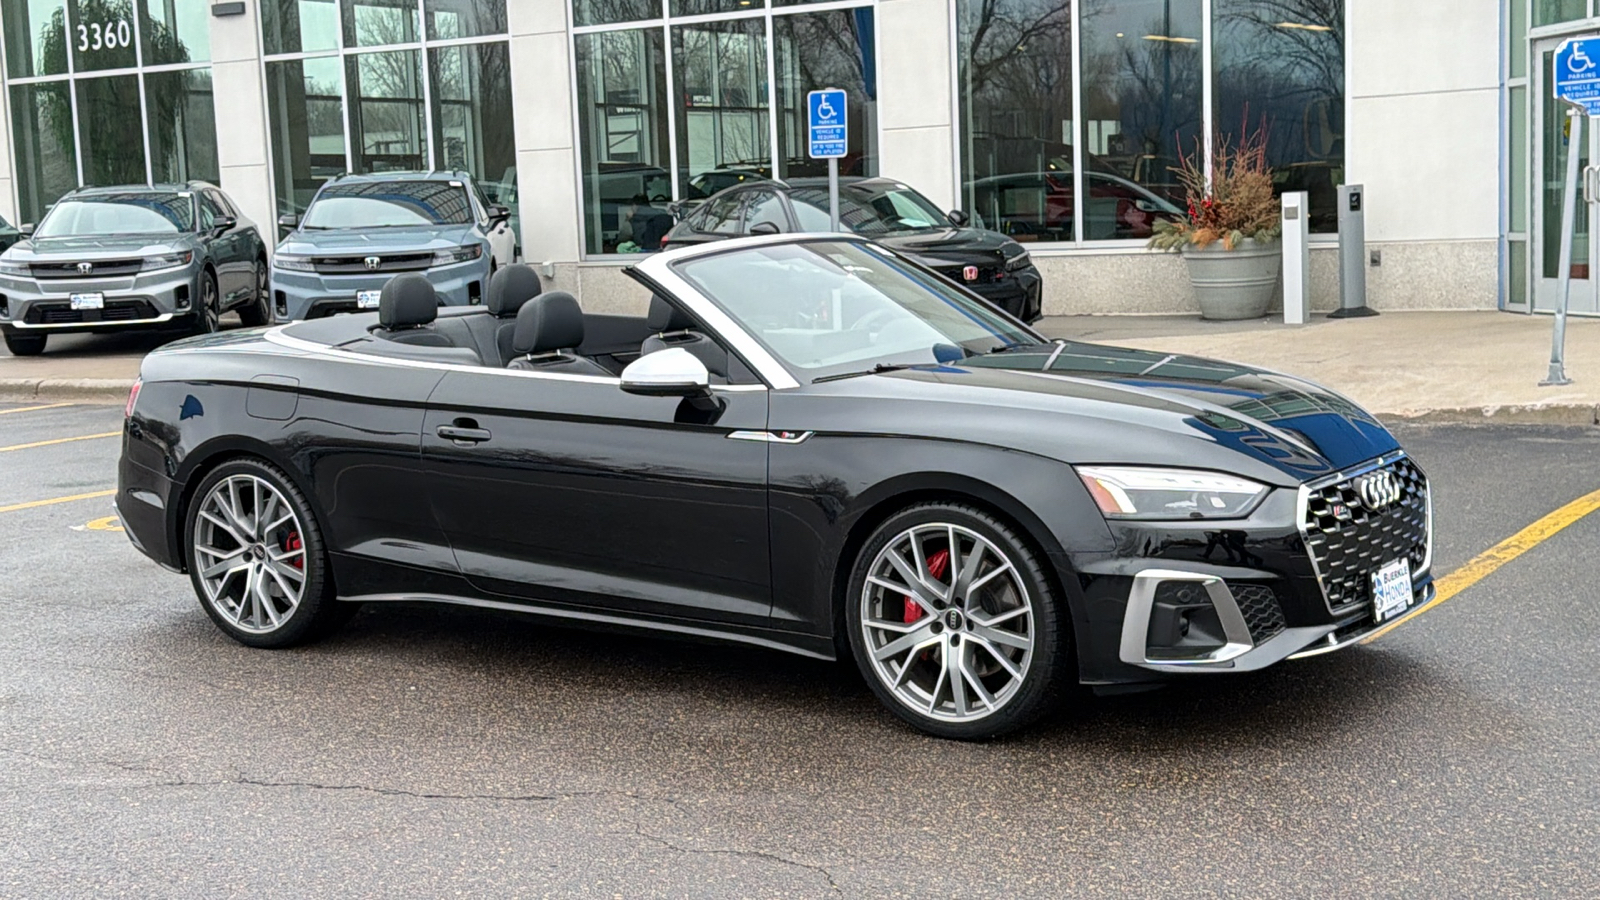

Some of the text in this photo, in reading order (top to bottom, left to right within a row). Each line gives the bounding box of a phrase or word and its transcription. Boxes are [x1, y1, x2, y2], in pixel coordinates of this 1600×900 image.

[77, 20, 130, 52] 3360
[1568, 72, 1596, 80] PARKING
[1564, 84, 1591, 92] VEHICLE
[1567, 90, 1600, 98] REQUIRED
[1385, 580, 1410, 603] HONDA
